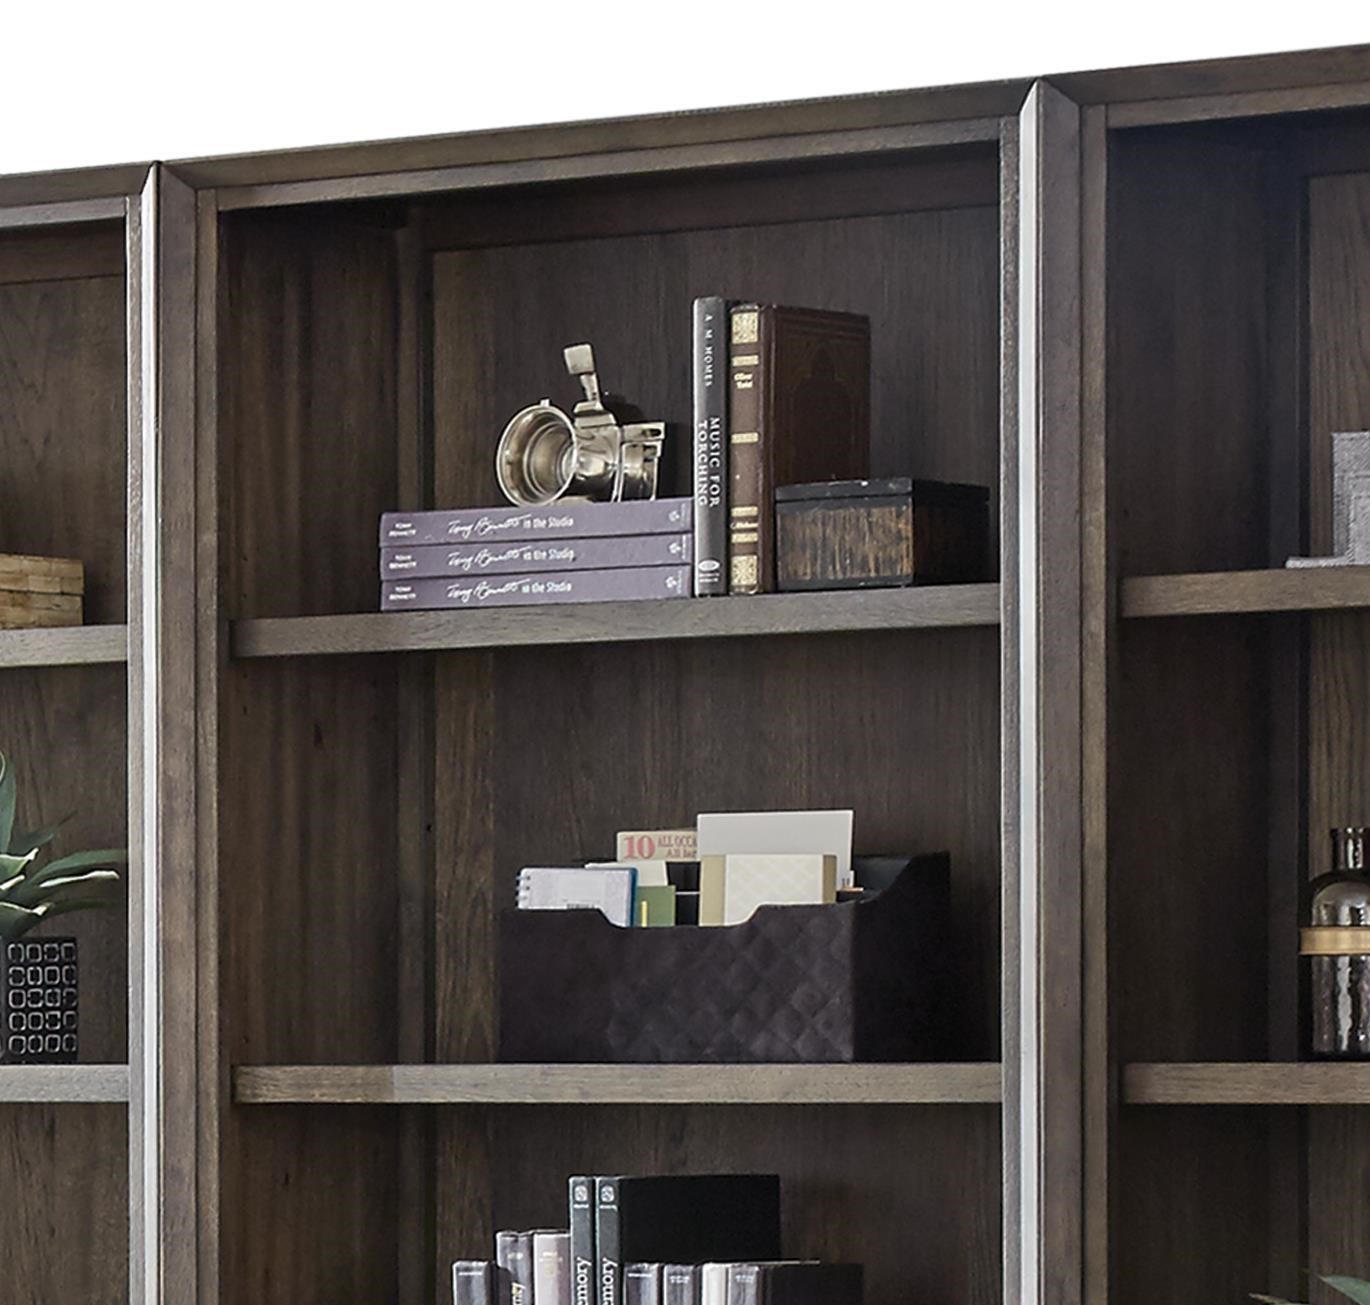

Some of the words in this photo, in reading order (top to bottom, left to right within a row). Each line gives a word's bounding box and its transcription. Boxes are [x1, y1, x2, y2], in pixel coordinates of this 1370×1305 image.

[709, 417, 721, 468] MUSIC
[698, 420, 709, 507] TORCHING
[709, 475, 721, 507] FOR
[548, 515, 574, 528] Studio
[548, 547, 575, 561] Studio
[546, 579, 573, 593] Studio
[623, 834, 656, 860] 10
